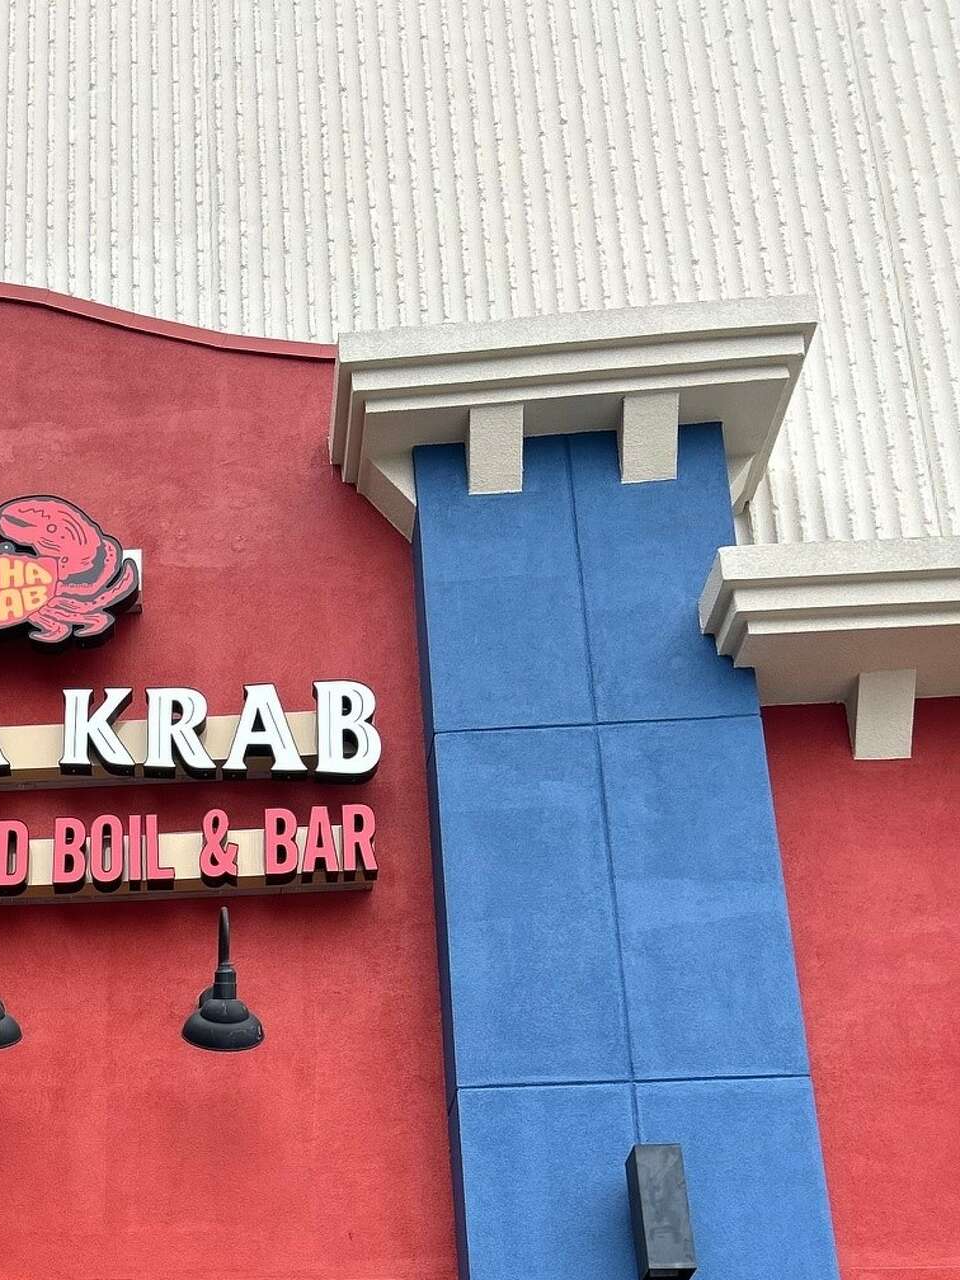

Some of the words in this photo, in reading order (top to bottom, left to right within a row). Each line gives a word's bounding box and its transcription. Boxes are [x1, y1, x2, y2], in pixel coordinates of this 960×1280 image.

[58, 680, 382, 779] KRAB
[53, 813, 176, 887] BOIL
[199, 808, 239, 878] &
[265, 803, 379, 878] BAR
